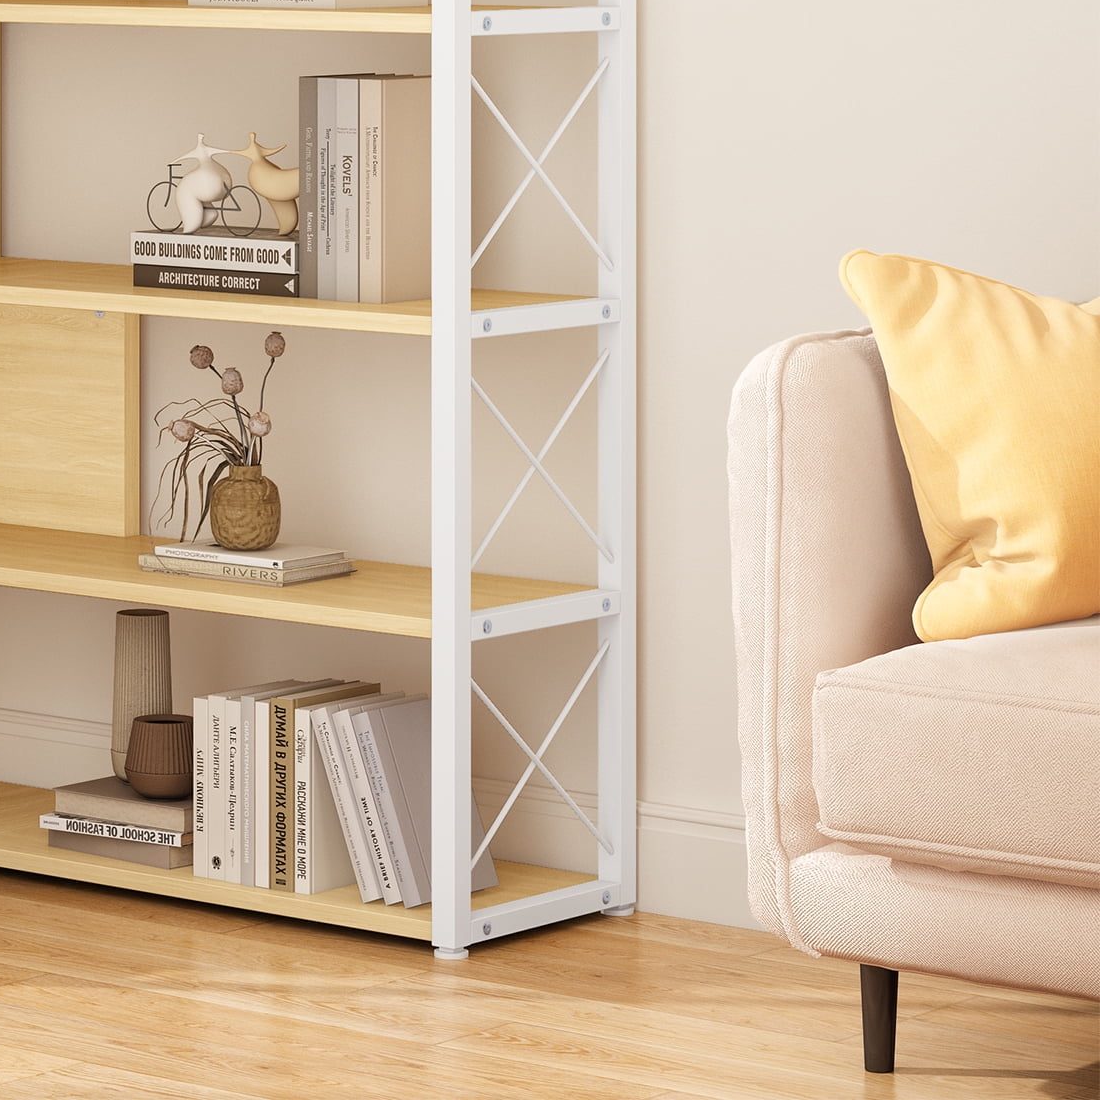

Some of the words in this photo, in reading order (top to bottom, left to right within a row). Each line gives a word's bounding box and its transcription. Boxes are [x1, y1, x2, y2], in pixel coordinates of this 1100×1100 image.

[134, 241, 156, 256] GOOD
[159, 242, 201, 260] BUILDINGS
[204, 245, 227, 261] COME
[230, 248, 254, 263] FROM
[257, 249, 279, 264] GOOD
[159, 272, 219, 287] ARCHITECTURE
[221, 276, 260, 290] CORRECT
[165, 549, 219, 560] PHOTOGRAPHY
[222, 566, 278, 581] RIVERS
[274, 705, 288, 747] ДУМАЙ
[274, 762, 286, 808] ДРУГИХ
[297, 780, 306, 826] РАССКАЖИ
[361, 796, 369, 813] TIME
[366, 815, 373, 826] OF
[275, 812, 286, 874] ФОРМАТАХ
[297, 828, 306, 846] МНЕ
[369, 828, 382, 859] HISTORY
[297, 856, 306, 879] МОРЕ
[379, 861, 388, 881] BRIEF
